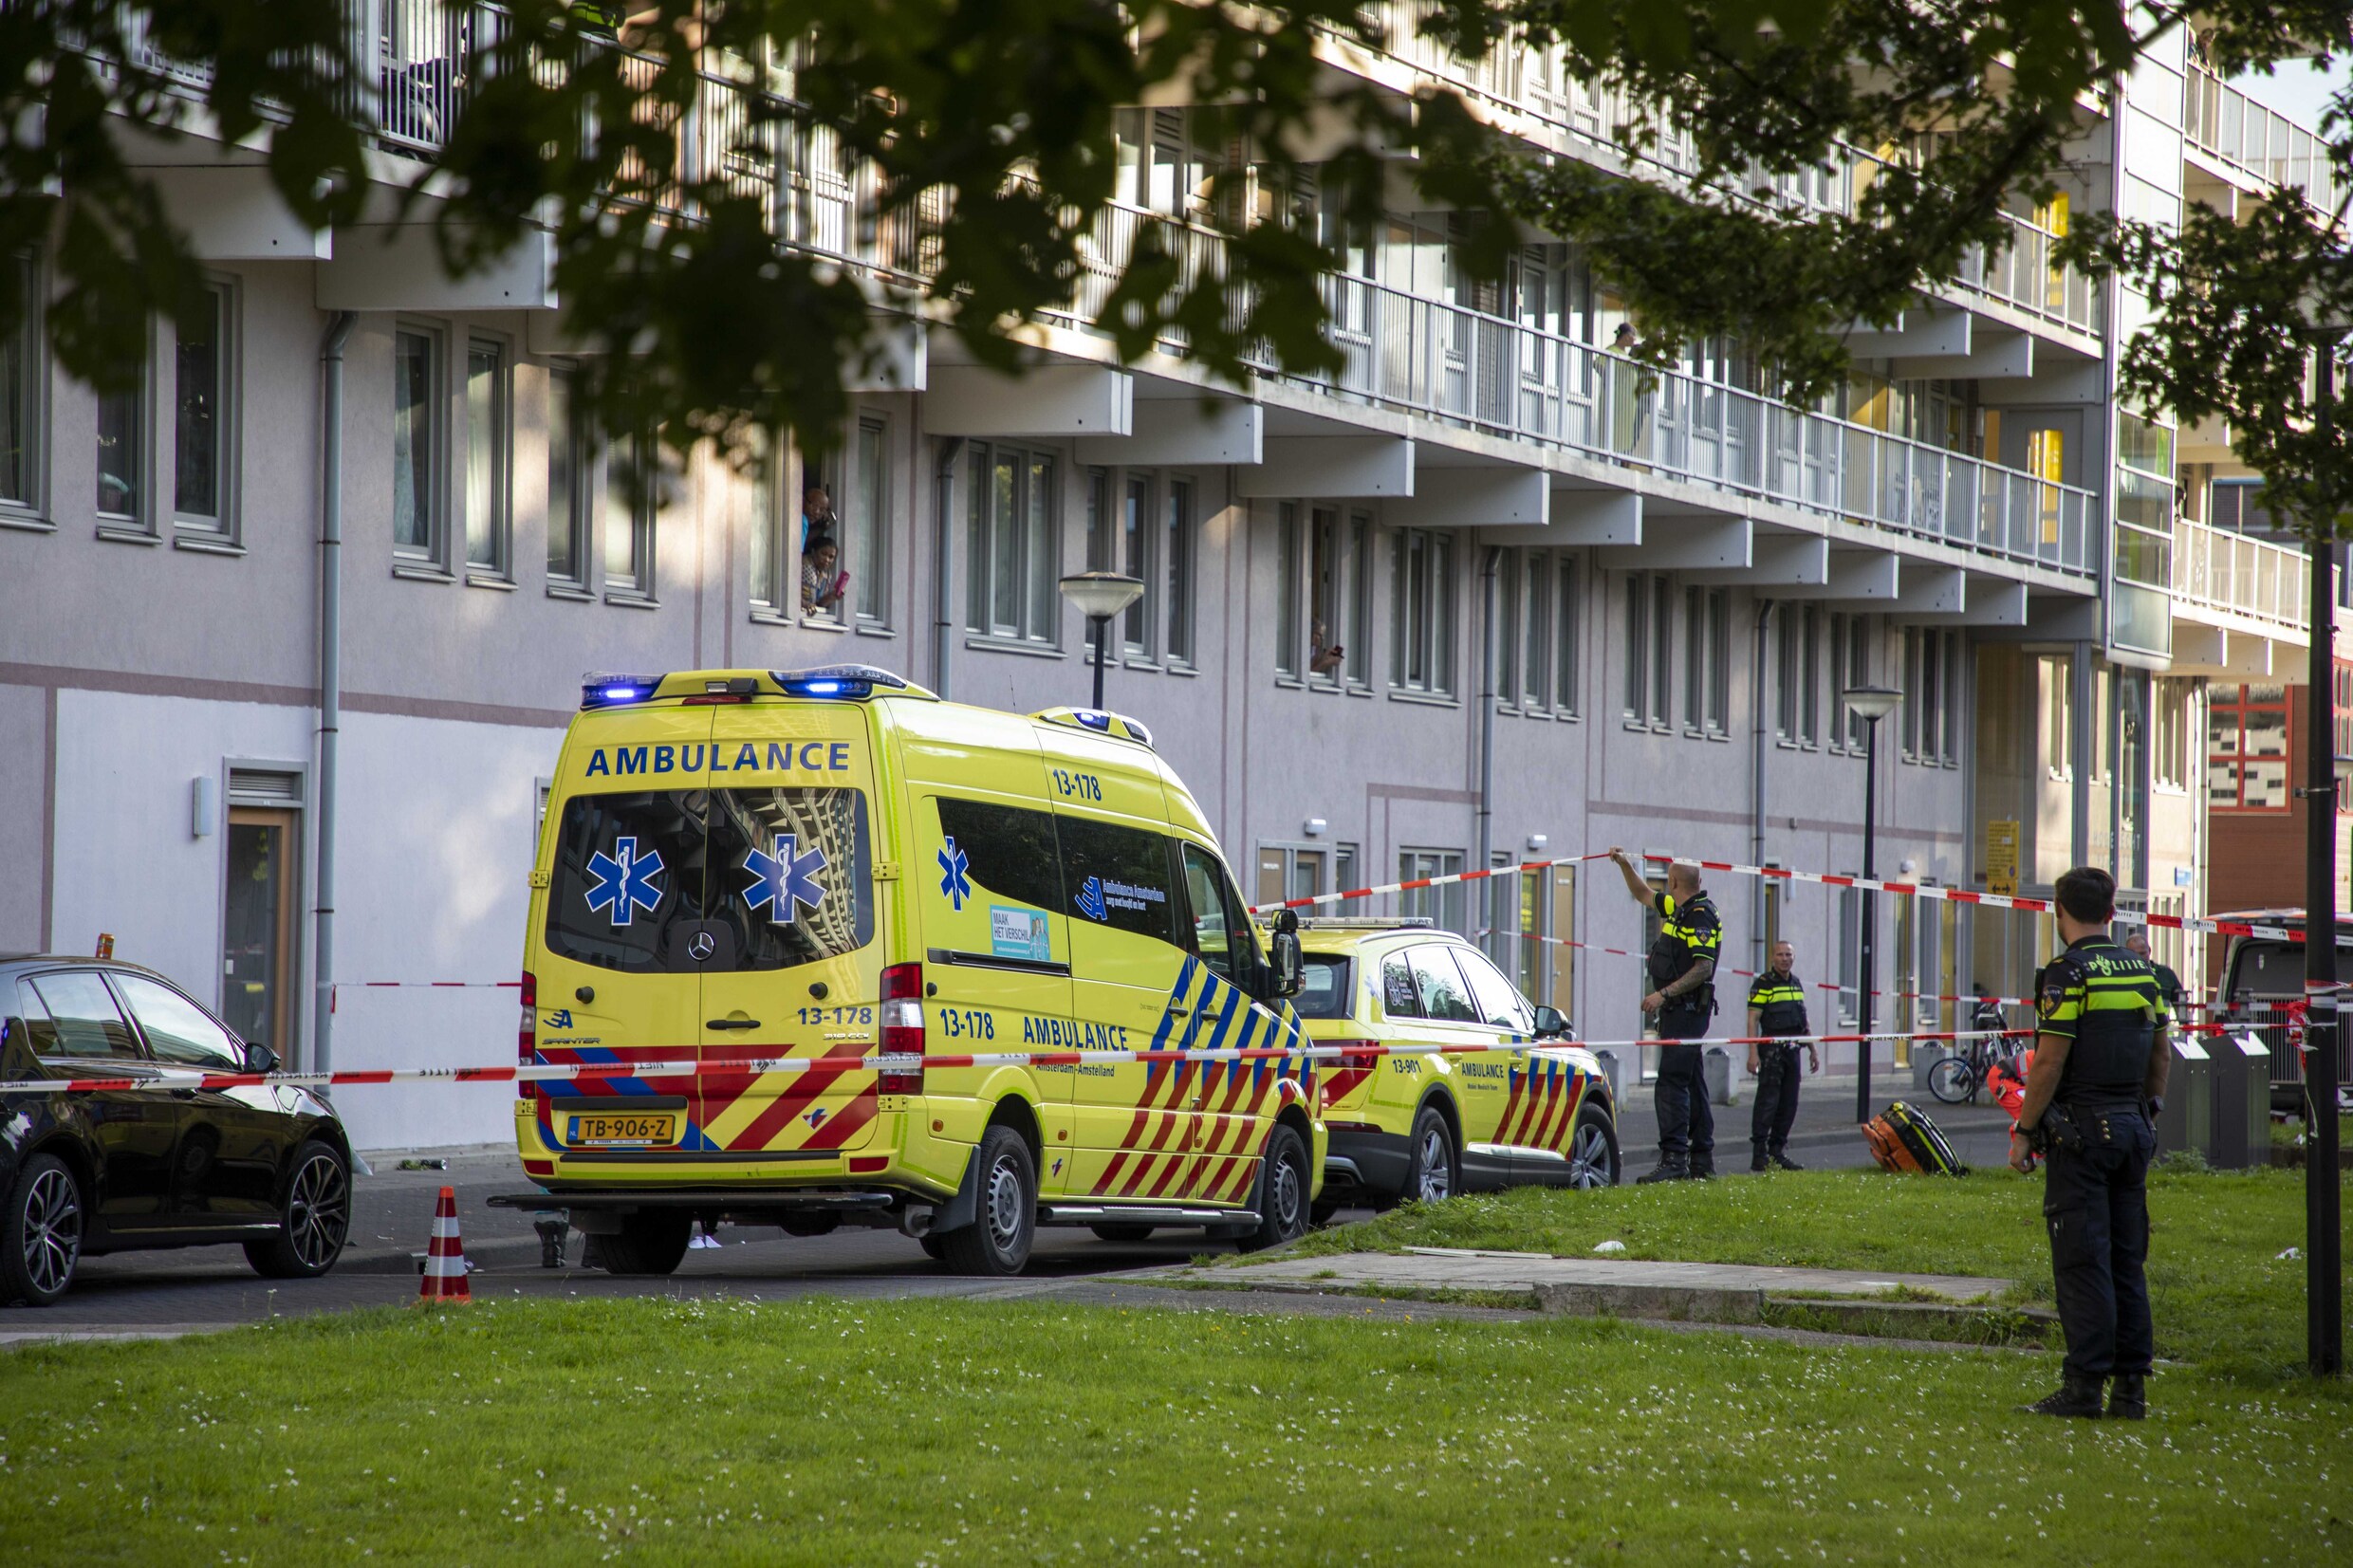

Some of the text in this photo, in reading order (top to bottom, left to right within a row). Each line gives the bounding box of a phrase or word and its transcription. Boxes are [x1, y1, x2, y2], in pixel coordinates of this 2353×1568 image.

[585, 742, 850, 778] AMBULANCE
[1052, 768, 1102, 802] 13-178
[992, 912, 1009, 926] MAAK
[994, 926, 1029, 942] HET VERSCHIL
[2088, 954, 2145, 976] POLITIE
[797, 1006, 872, 1024] 13-178
[940, 1008, 994, 1041] 13-178
[1023, 1016, 1128, 1051] AMBULANCE
[542, 1037, 601, 1045] SPRINTER
[847, 1032, 870, 1041] CDI
[1392, 1059, 1422, 1074] 13-901
[1461, 1061, 1505, 1079] AMBULANCE
[584, 1118, 667, 1137] TB-906-Z
